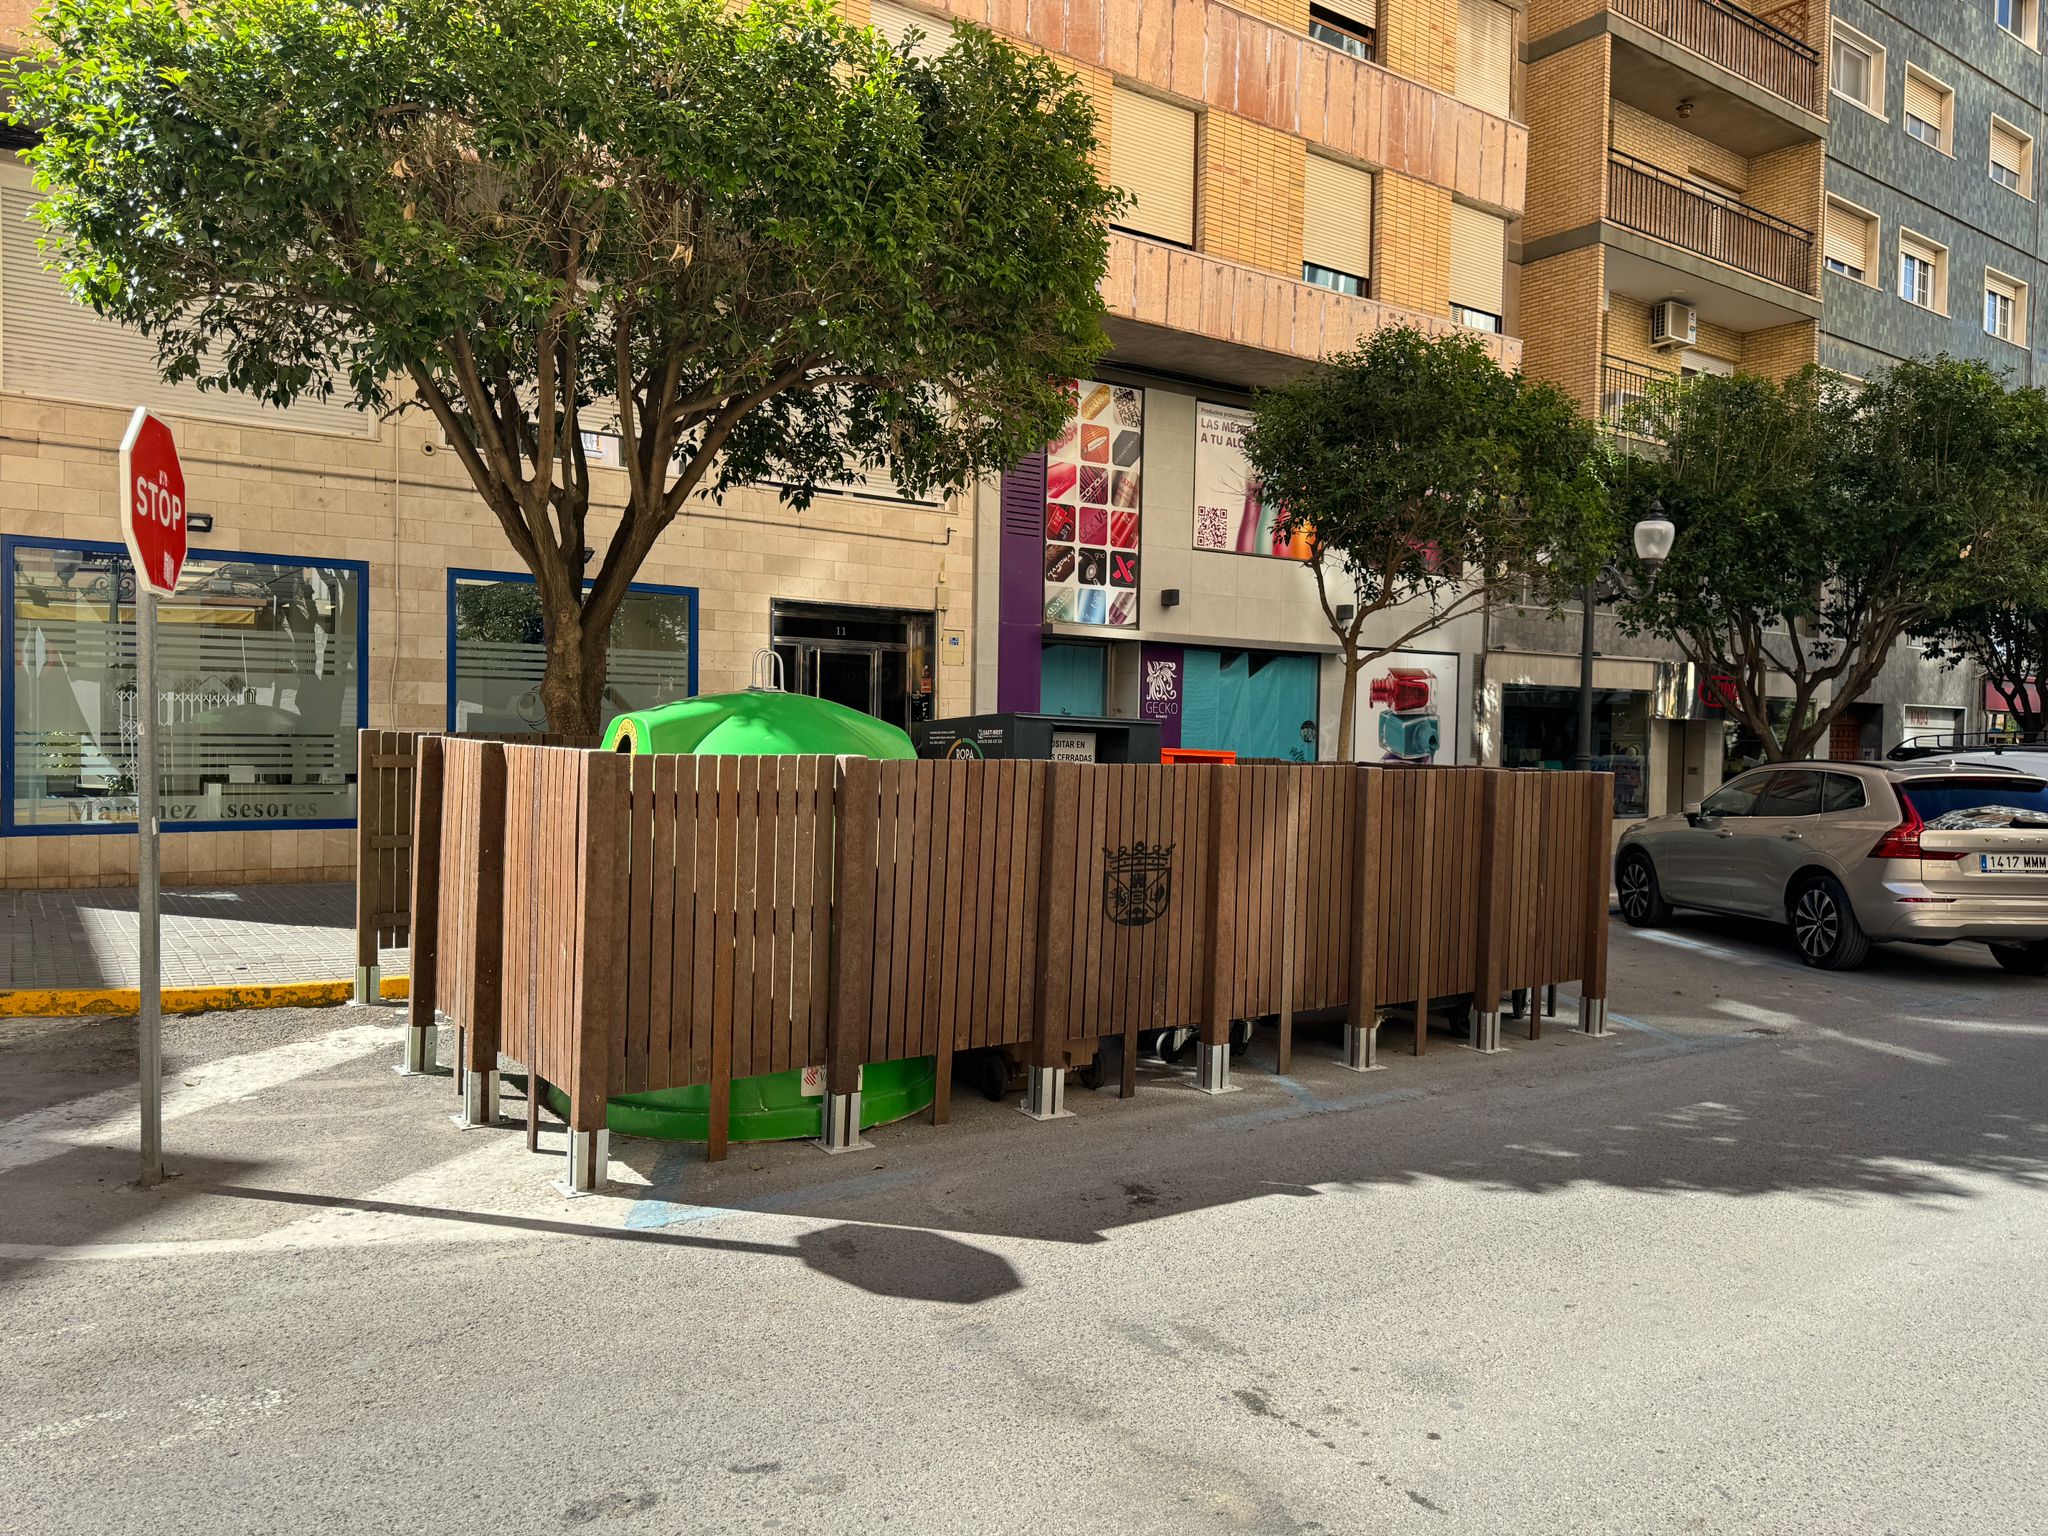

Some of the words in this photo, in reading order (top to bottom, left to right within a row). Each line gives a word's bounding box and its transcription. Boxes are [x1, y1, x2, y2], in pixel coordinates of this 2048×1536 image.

[1201, 418, 1219, 430] LAS
[1200, 433, 1208, 443] A
[1211, 434, 1223, 445] TU
[136, 475, 182, 531] STOP
[836, 626, 847, 636] 11
[1145, 701, 1179, 715] GECKO
[1076, 741, 1086, 749] EN
[955, 748, 975, 759] ROPA
[1057, 753, 1093, 763] CERRADAS
[207, 801, 319, 820] sesores
[1990, 855, 2020, 869] 1417
[2023, 856, 2047, 869] MMM
